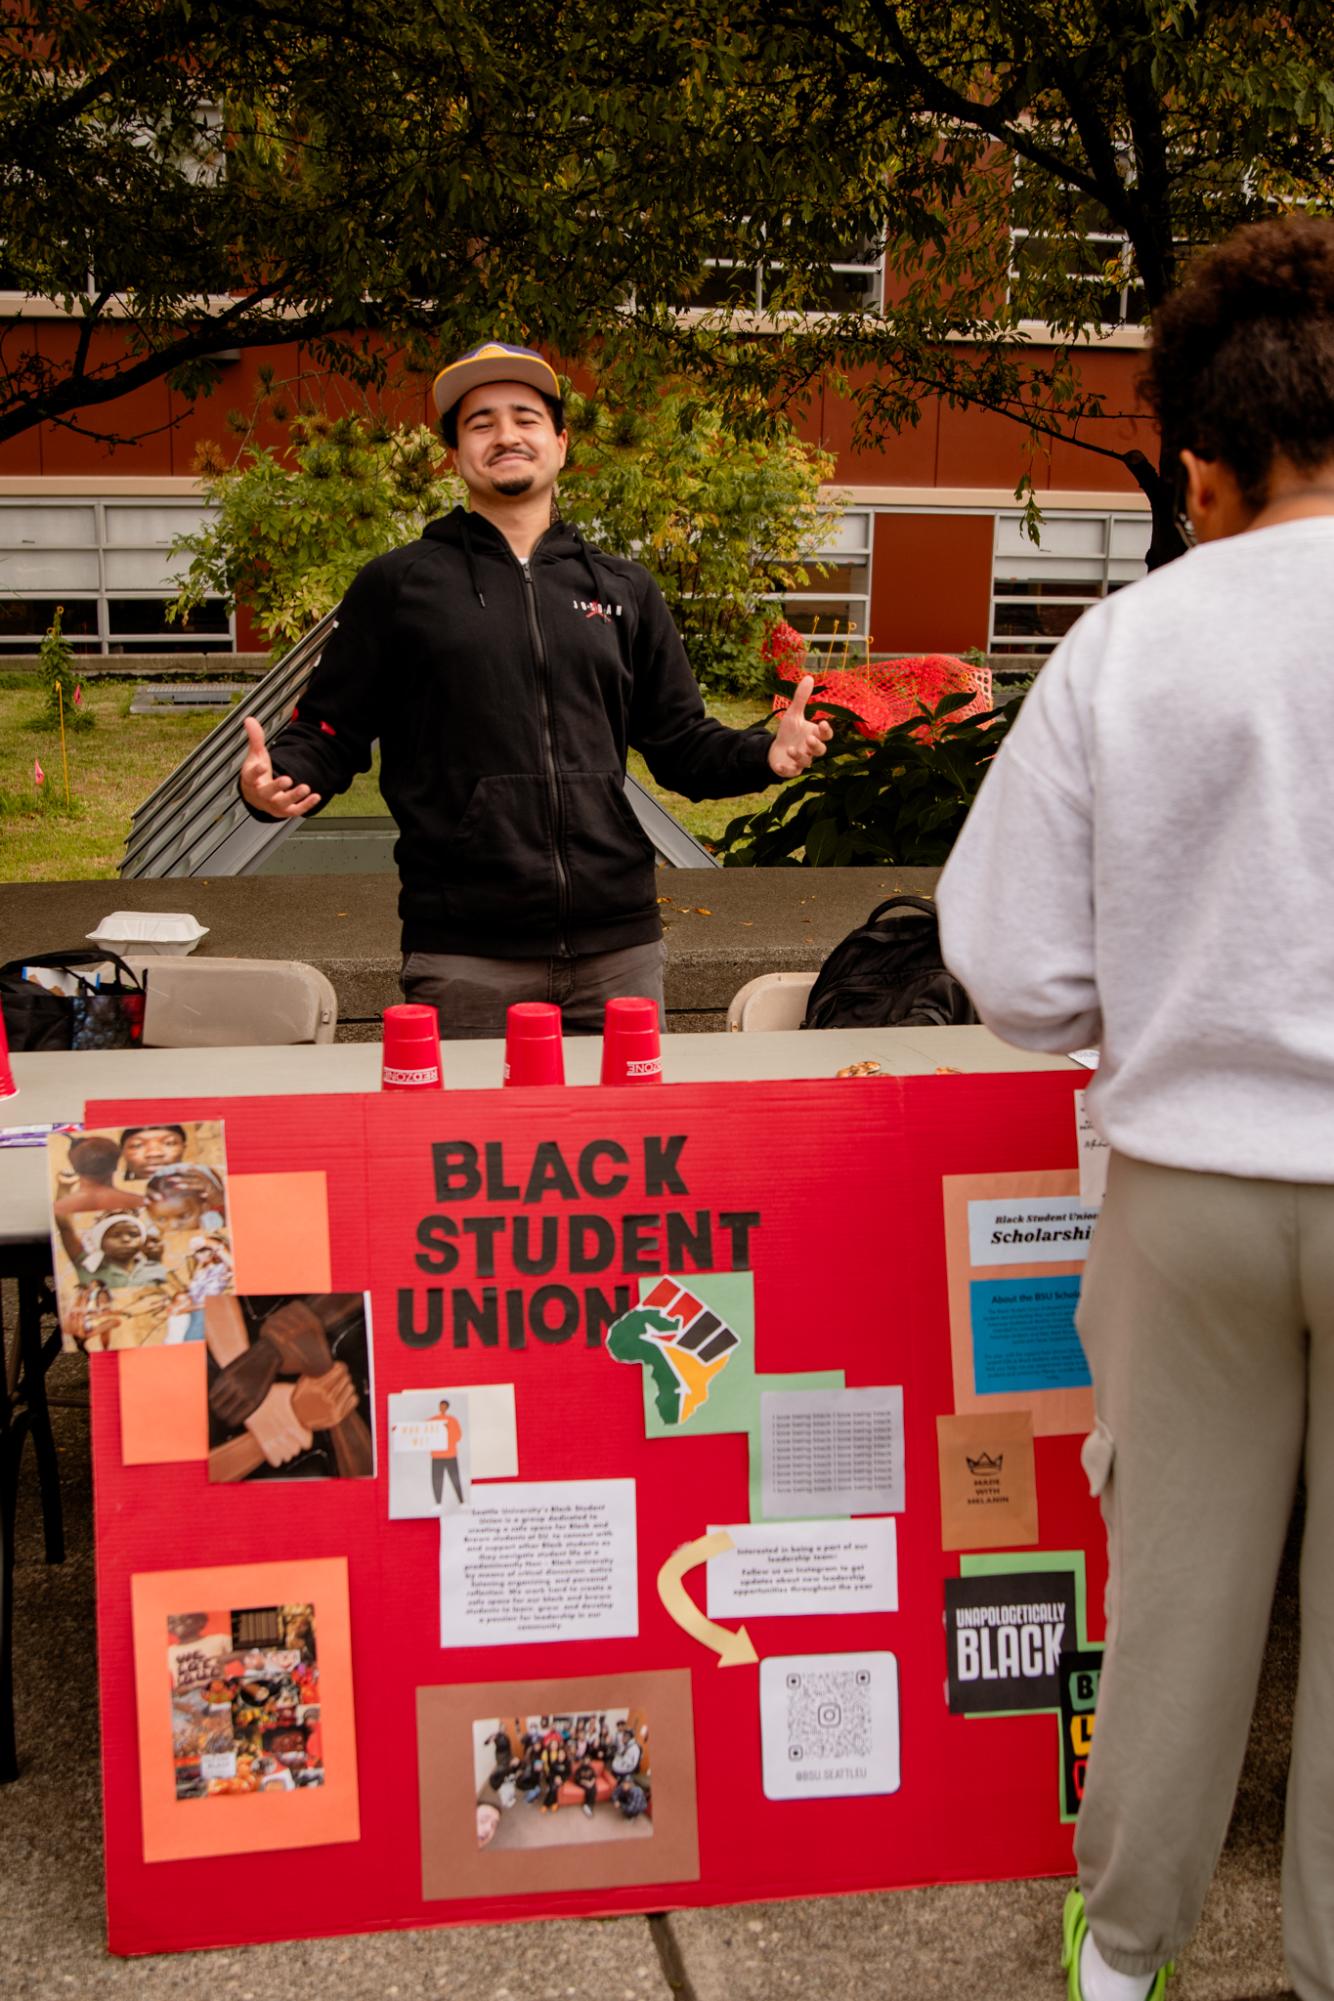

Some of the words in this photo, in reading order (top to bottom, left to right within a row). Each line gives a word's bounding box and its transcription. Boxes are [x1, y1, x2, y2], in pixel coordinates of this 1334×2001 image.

[384, 1069, 438, 1082] REDZONE
[432, 1136, 689, 1204] BLACK
[995, 1215, 1024, 1224] Black
[1026, 1213, 1067, 1223] Student
[414, 1210, 760, 1278] STUDENT
[991, 1225, 1094, 1244] Scholarshi
[397, 1284, 630, 1350] UNION
[967, 1496, 1009, 1505] MELANIN
[976, 1488, 1000, 1496] WITH
[956, 1602, 1066, 1628] UNAPOLOGETICALLY
[956, 1622, 1065, 1682] BLACK
